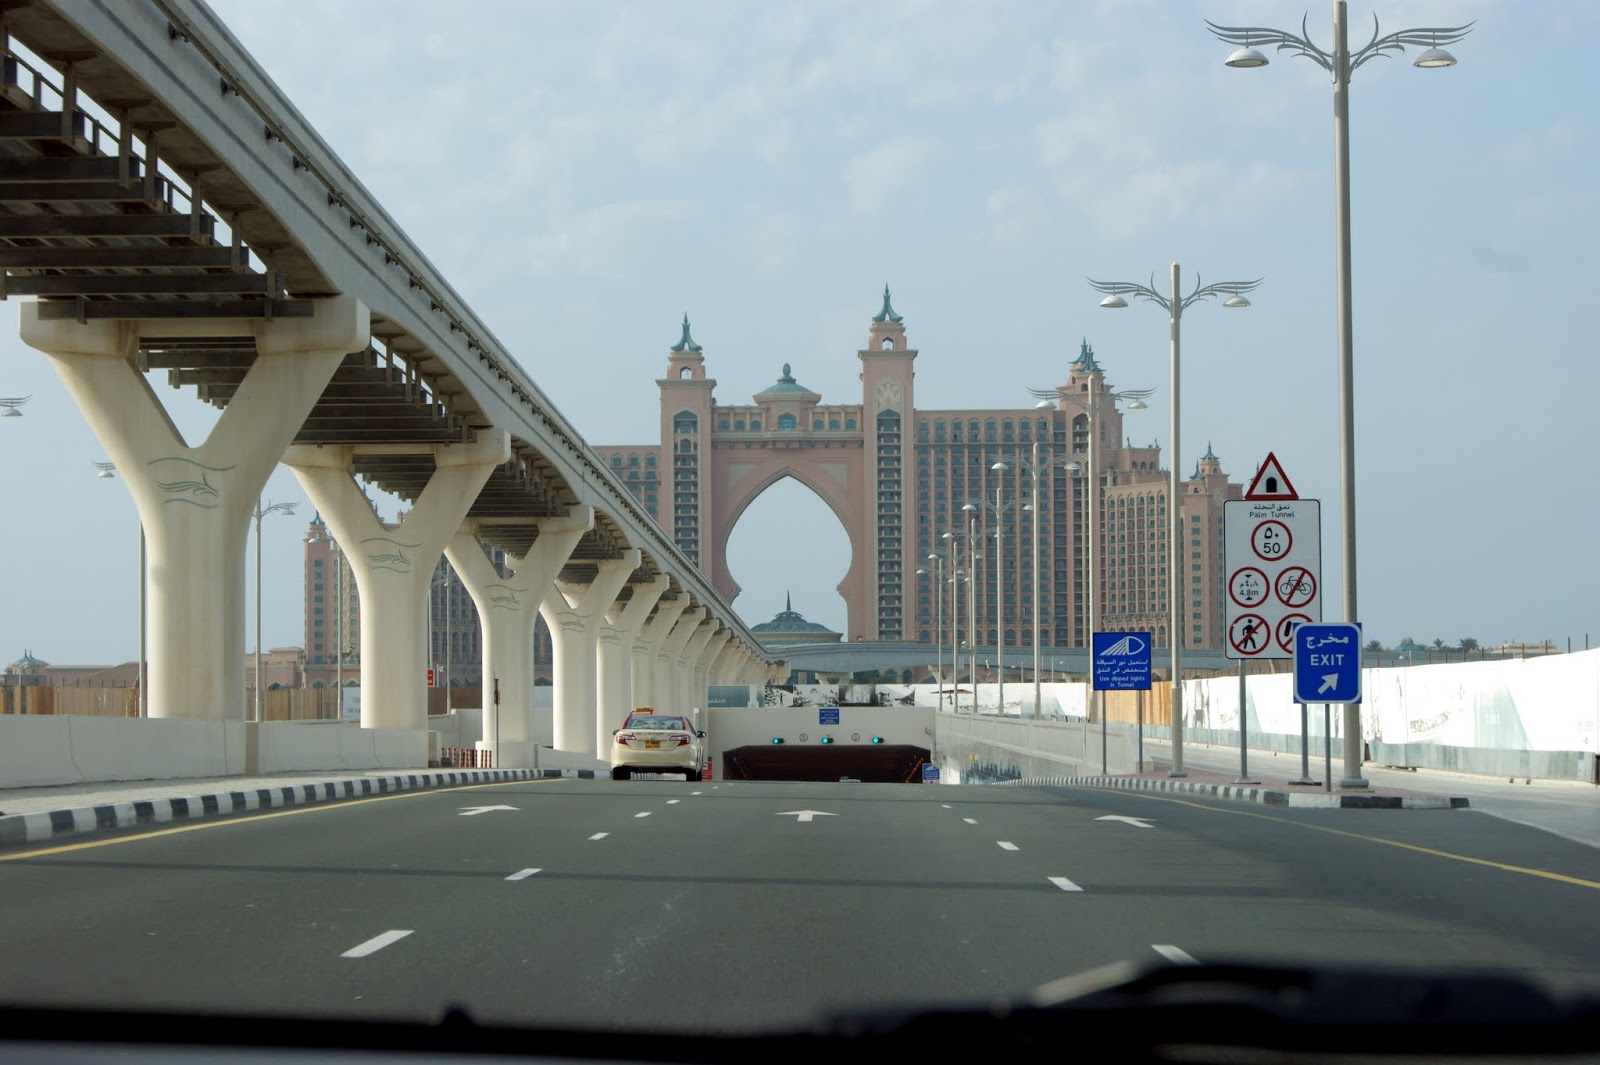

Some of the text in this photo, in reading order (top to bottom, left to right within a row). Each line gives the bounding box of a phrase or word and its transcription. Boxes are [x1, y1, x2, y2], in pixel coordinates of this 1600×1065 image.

[1263, 542, 1281, 554] 50
[1306, 633, 1349, 649] مخرج
[1310, 654, 1344, 666] EXIT
